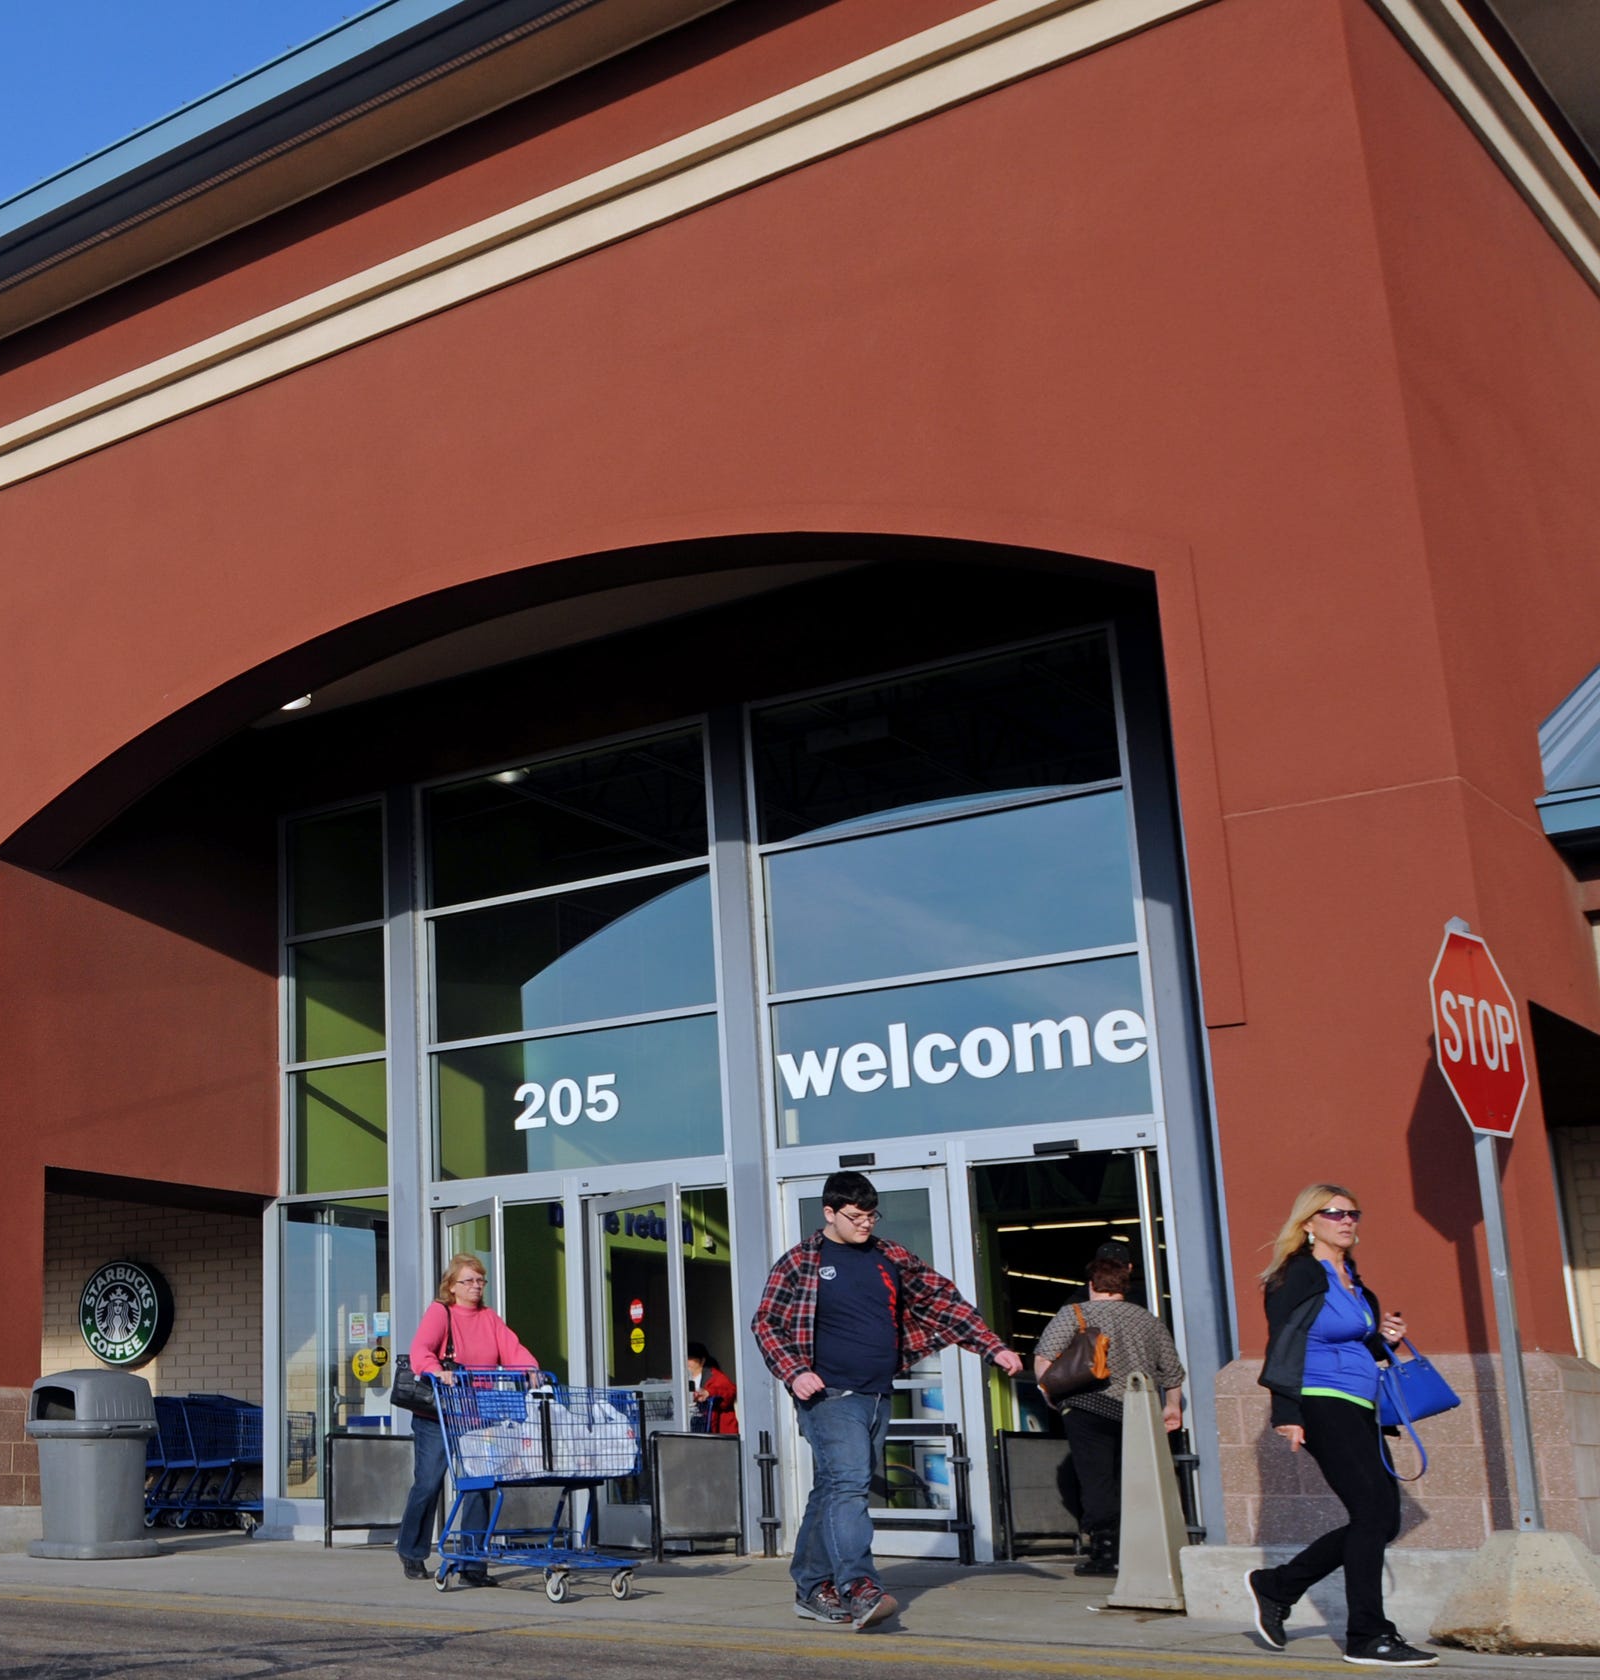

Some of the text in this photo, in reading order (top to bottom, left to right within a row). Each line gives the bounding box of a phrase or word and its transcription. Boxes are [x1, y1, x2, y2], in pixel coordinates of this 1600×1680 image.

[776, 1009, 1149, 1100] welcome
[1440, 989, 1514, 1073] STOP
[513, 1073, 619, 1130] 205
[623, 1209, 694, 1246] retun
[85, 1267, 154, 1309] STARBUCKS
[90, 1332, 143, 1359] COFFEE
